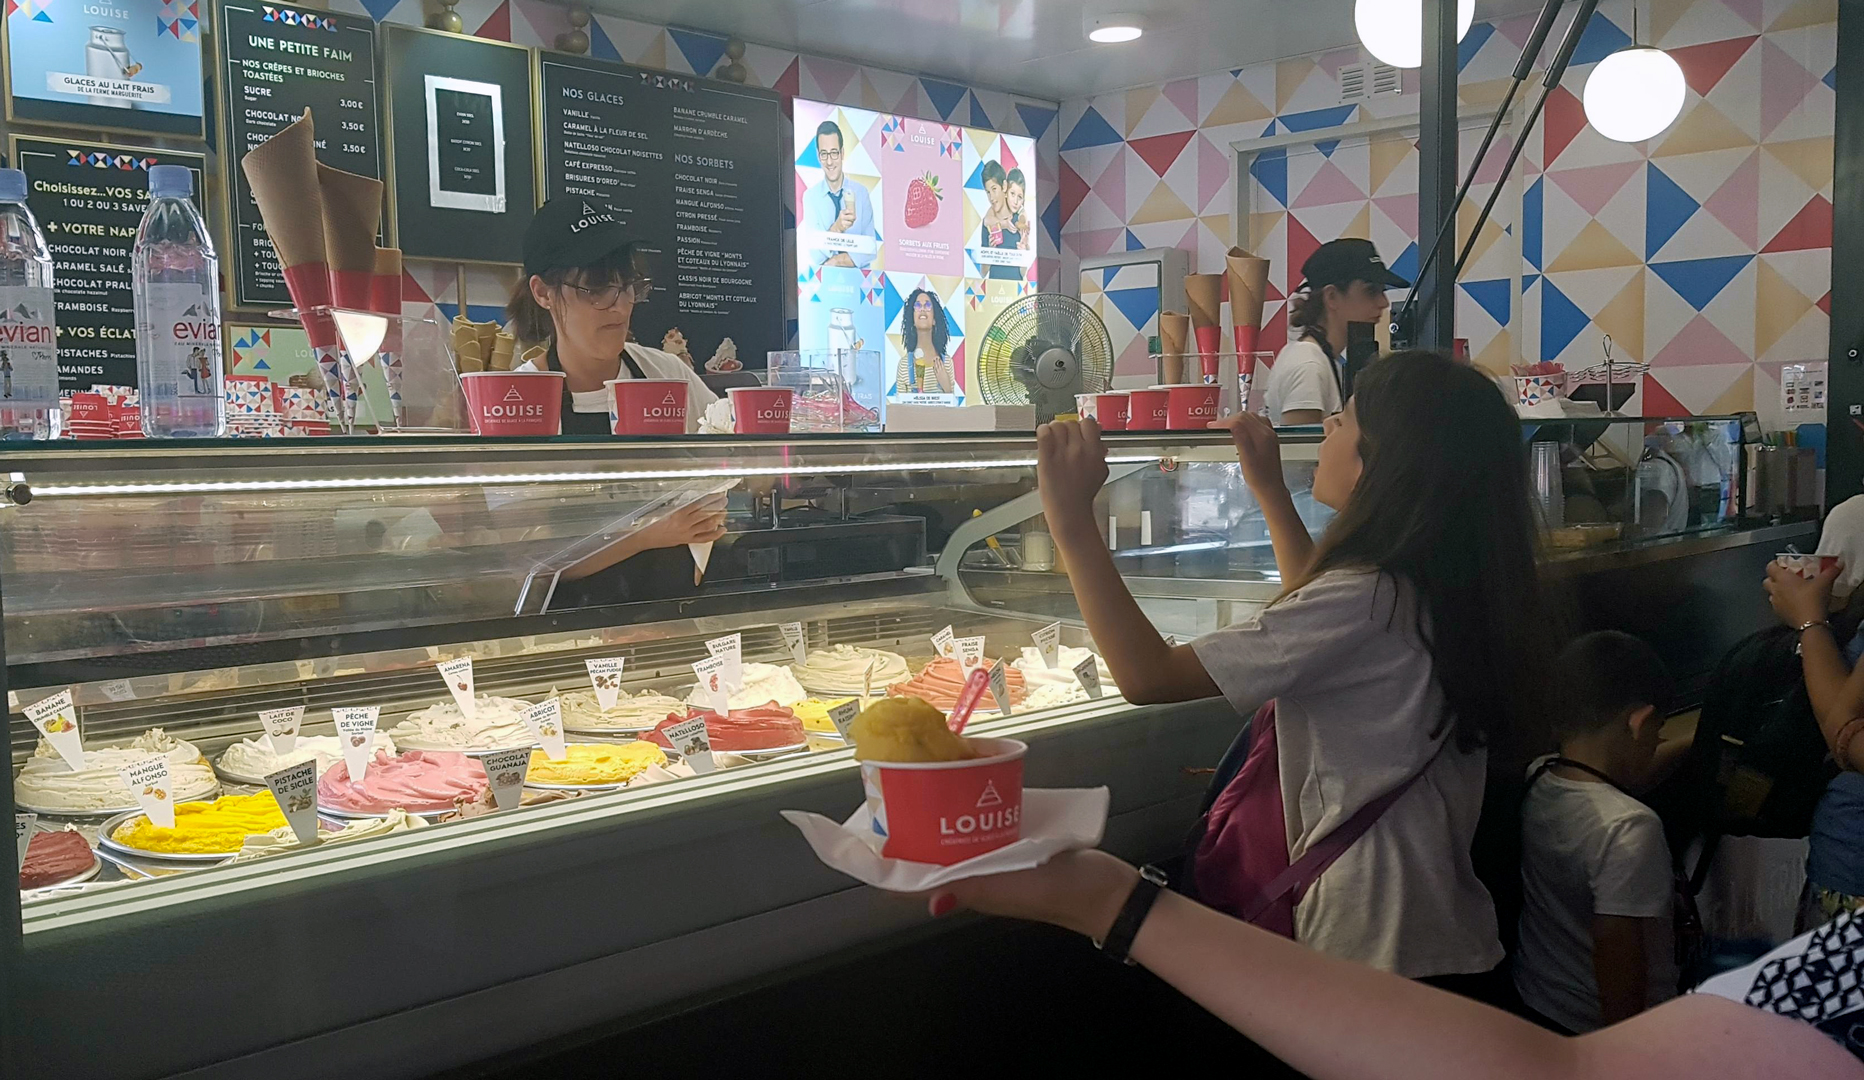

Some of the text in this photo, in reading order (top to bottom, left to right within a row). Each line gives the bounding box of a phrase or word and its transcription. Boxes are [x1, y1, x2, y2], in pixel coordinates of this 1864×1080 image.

[83, 4, 129, 19] LOUISE
[248, 35, 353, 62] UNE PETITE FAIM
[242, 59, 345, 82] NOS CRÊPES ET BRIOCHES
[242, 69, 284, 83] TOASTÉES
[63, 77, 155, 94] GLACES AU LAIT FRAIS
[244, 85, 272, 97] SUCRE
[111, 90, 143, 99] MARGUERITE
[562, 87, 624, 106] NOS GLACES
[245, 109, 289, 122] CHOCOLAT
[562, 108, 590, 119] VANILLE
[673, 106, 696, 116] BANANE
[696, 110, 722, 120] CRUMBLE
[722, 114, 748, 124] CARAMEL
[563, 121, 592, 132] CARAMEL
[593, 125, 599, 133] À
[608, 128, 627, 137] FLEUR
[637, 132, 648, 140] SEL
[673, 124, 697, 135] MARRON
[910, 134, 935, 145] LOUISE
[564, 140, 600, 152] NATELLOSO
[600, 145, 631, 156] CHOCOLAT
[632, 150, 663, 160] NOISETTES
[564, 160, 581, 169] CAFÉ
[581, 162, 613, 172] EXPRESSO
[674, 153, 734, 170] NOS SORBETS
[565, 173, 595, 183] BRISURES
[674, 173, 703, 183] CHOCOLAT
[565, 186, 596, 197] PISTACHE
[675, 186, 695, 194] FRAISE
[695, 188, 714, 197] SENGA
[63, 198, 67, 206] 1
[70, 199, 84, 208] OU
[87, 200, 94, 209] 2
[96, 201, 110, 210] OU
[112, 202, 119, 210] 3
[675, 199, 699, 207] MANGUE
[699, 201, 724, 210] ALFONSO
[675, 211, 696, 219] CITRON
[697, 213, 718, 221] PRESSÉ
[62, 223, 105, 236] VOTRE
[570, 214, 615, 233] LOUISE
[676, 223, 708, 233] FRAMBOISE
[676, 236, 701, 244] PASSION
[898, 238, 921, 247] SORBETS
[932, 242, 949, 250] FRUITS
[48, 244, 126, 257] CHOCOLAT NOIR
[677, 247, 695, 256] PÊCHE
[685, 257, 711, 265] COTEAUX
[99, 261, 125, 274] SALÉ
[678, 274, 698, 282] CASSIS
[720, 278, 753, 286] BOURGOGNE
[679, 292, 702, 300] ABRICOT
[0, 321, 51, 343] vian
[67, 326, 95, 338] VOS
[57, 365, 104, 375] AMANDES
[483, 404, 544, 417] LOUISE
[643, 407, 686, 417] LOUISE
[715, 644, 736, 653] NATURE
[444, 662, 470, 673] AMARENA
[696, 660, 724, 673] FRAMBOISE
[35, 698, 66, 716] BANANE
[529, 704, 556, 719] ABRICOT
[272, 716, 293, 724] COCO
[345, 712, 369, 720] PÊCHE
[669, 722, 705, 739] NATELLOSO
[486, 752, 530, 765] CHOCOLAT
[129, 762, 164, 778] MANGUE
[490, 760, 527, 772] GUANAJA
[131, 770, 168, 786] ALFONSO
[274, 767, 313, 787] PISTACHE
[277, 776, 314, 794] DE SICILE
[940, 805, 1020, 835] LOUISE
